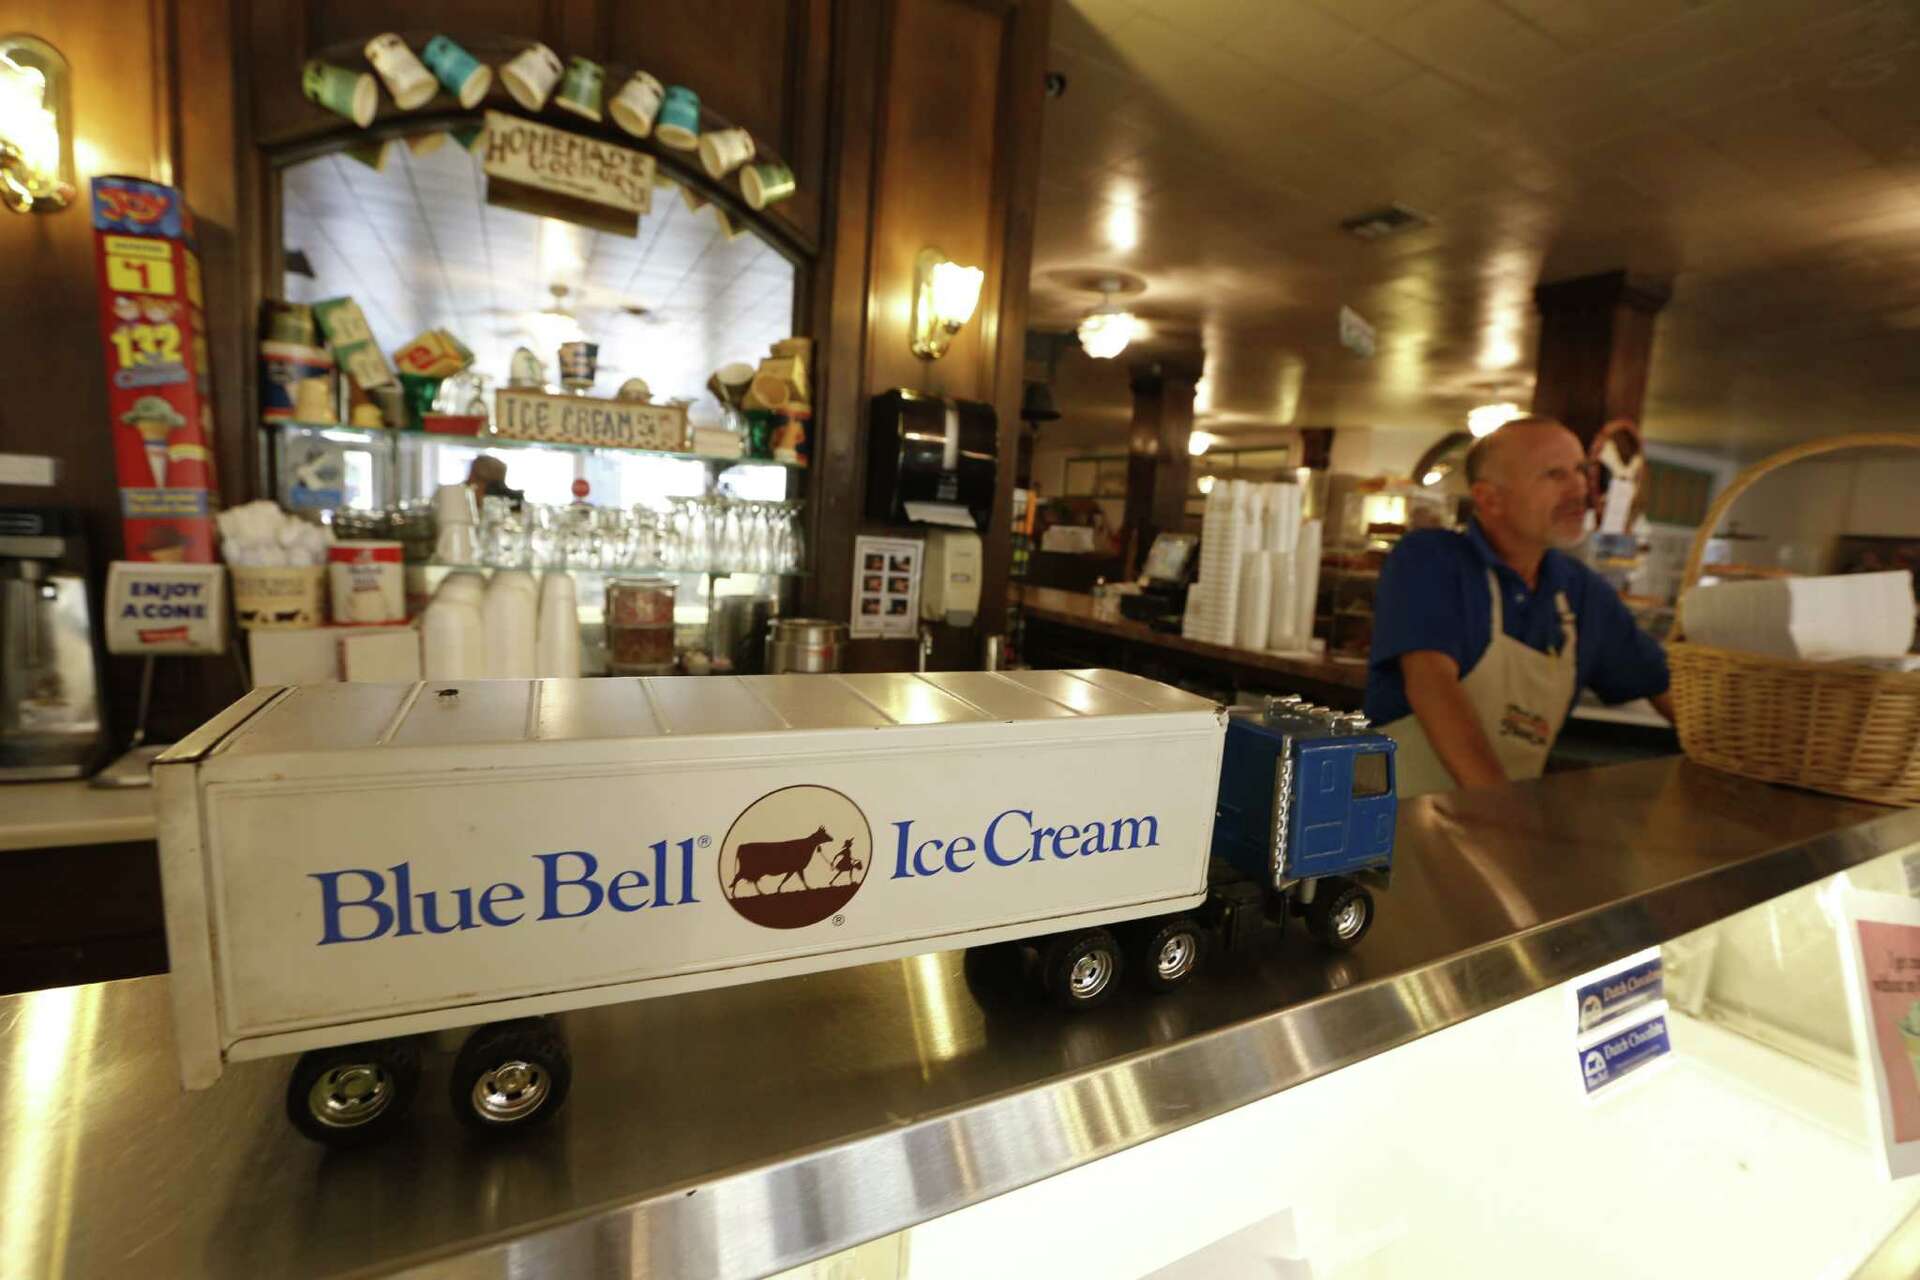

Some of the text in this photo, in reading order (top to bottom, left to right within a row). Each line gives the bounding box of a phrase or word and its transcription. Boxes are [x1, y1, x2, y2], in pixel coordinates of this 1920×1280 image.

[486, 125, 646, 178] HOMEMADE
[506, 397, 550, 434] ICE
[561, 405, 635, 441] CREAM
[122, 603, 207, 619] A CONE
[130, 581, 203, 601] ENJOY
[306, 861, 525, 946] Blue
[890, 820, 976, 880] Ice
[984, 809, 1161, 867] Cream
